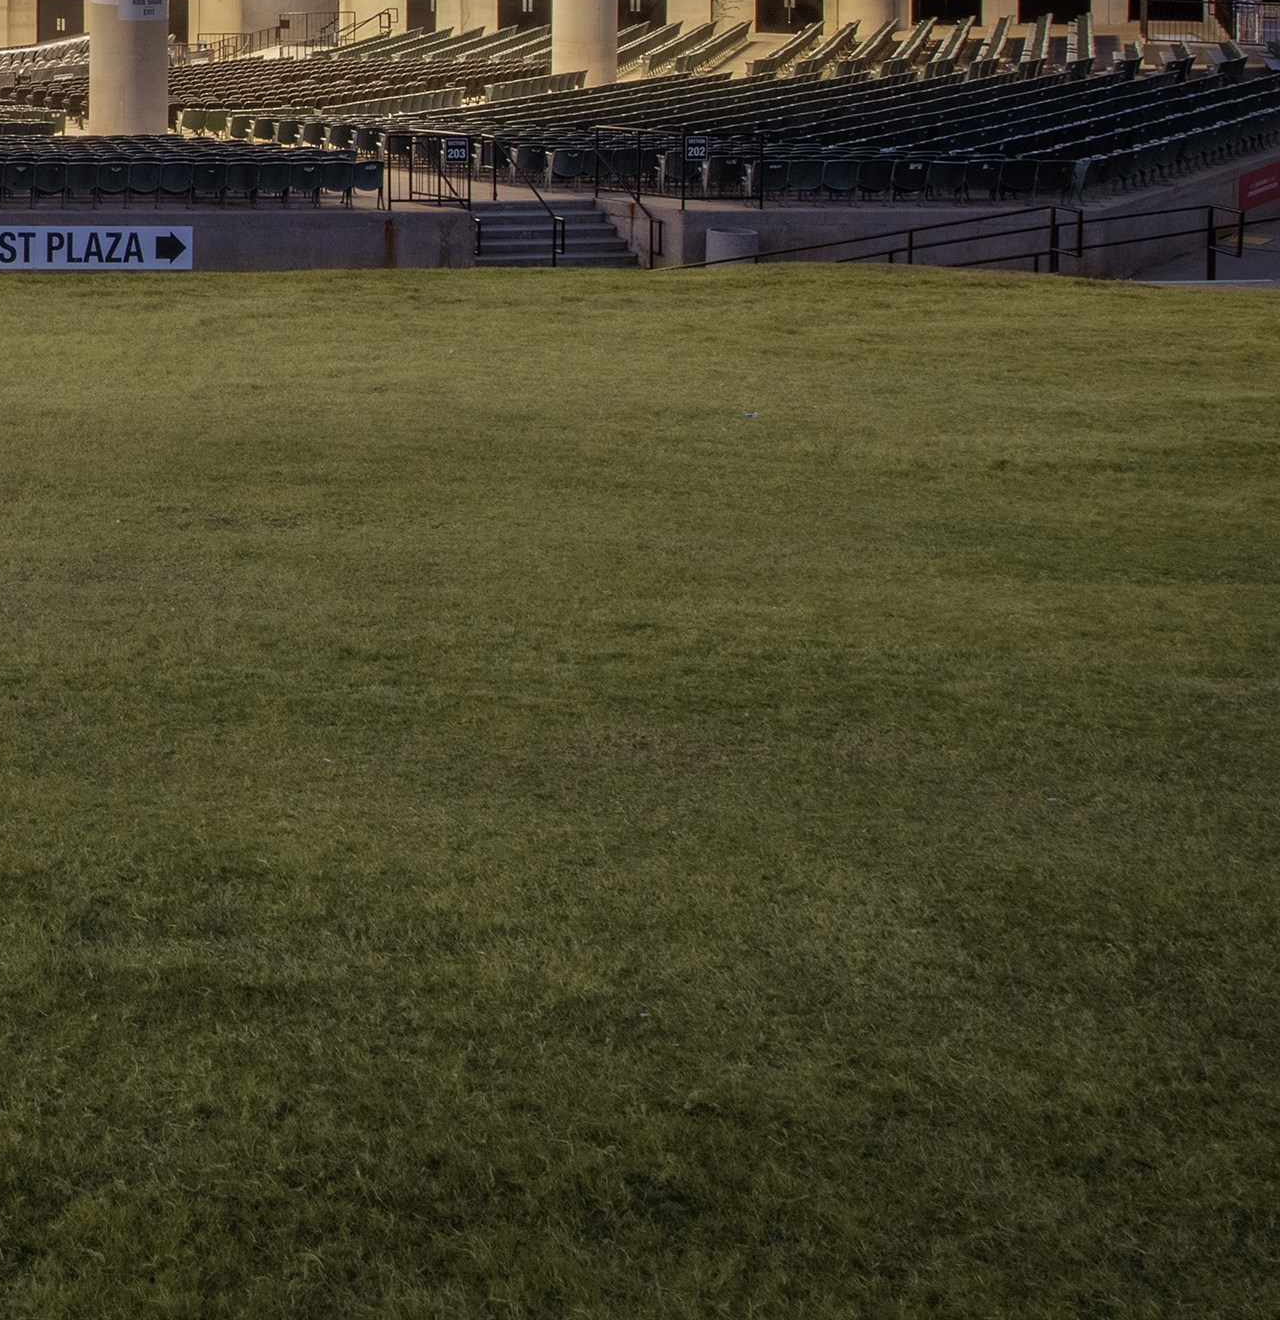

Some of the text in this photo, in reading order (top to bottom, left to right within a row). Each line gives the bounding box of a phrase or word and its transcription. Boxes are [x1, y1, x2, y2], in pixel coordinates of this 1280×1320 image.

[447, 148, 466, 159] 203
[687, 146, 706, 157] 202
[46, 231, 144, 264] PLAZA
